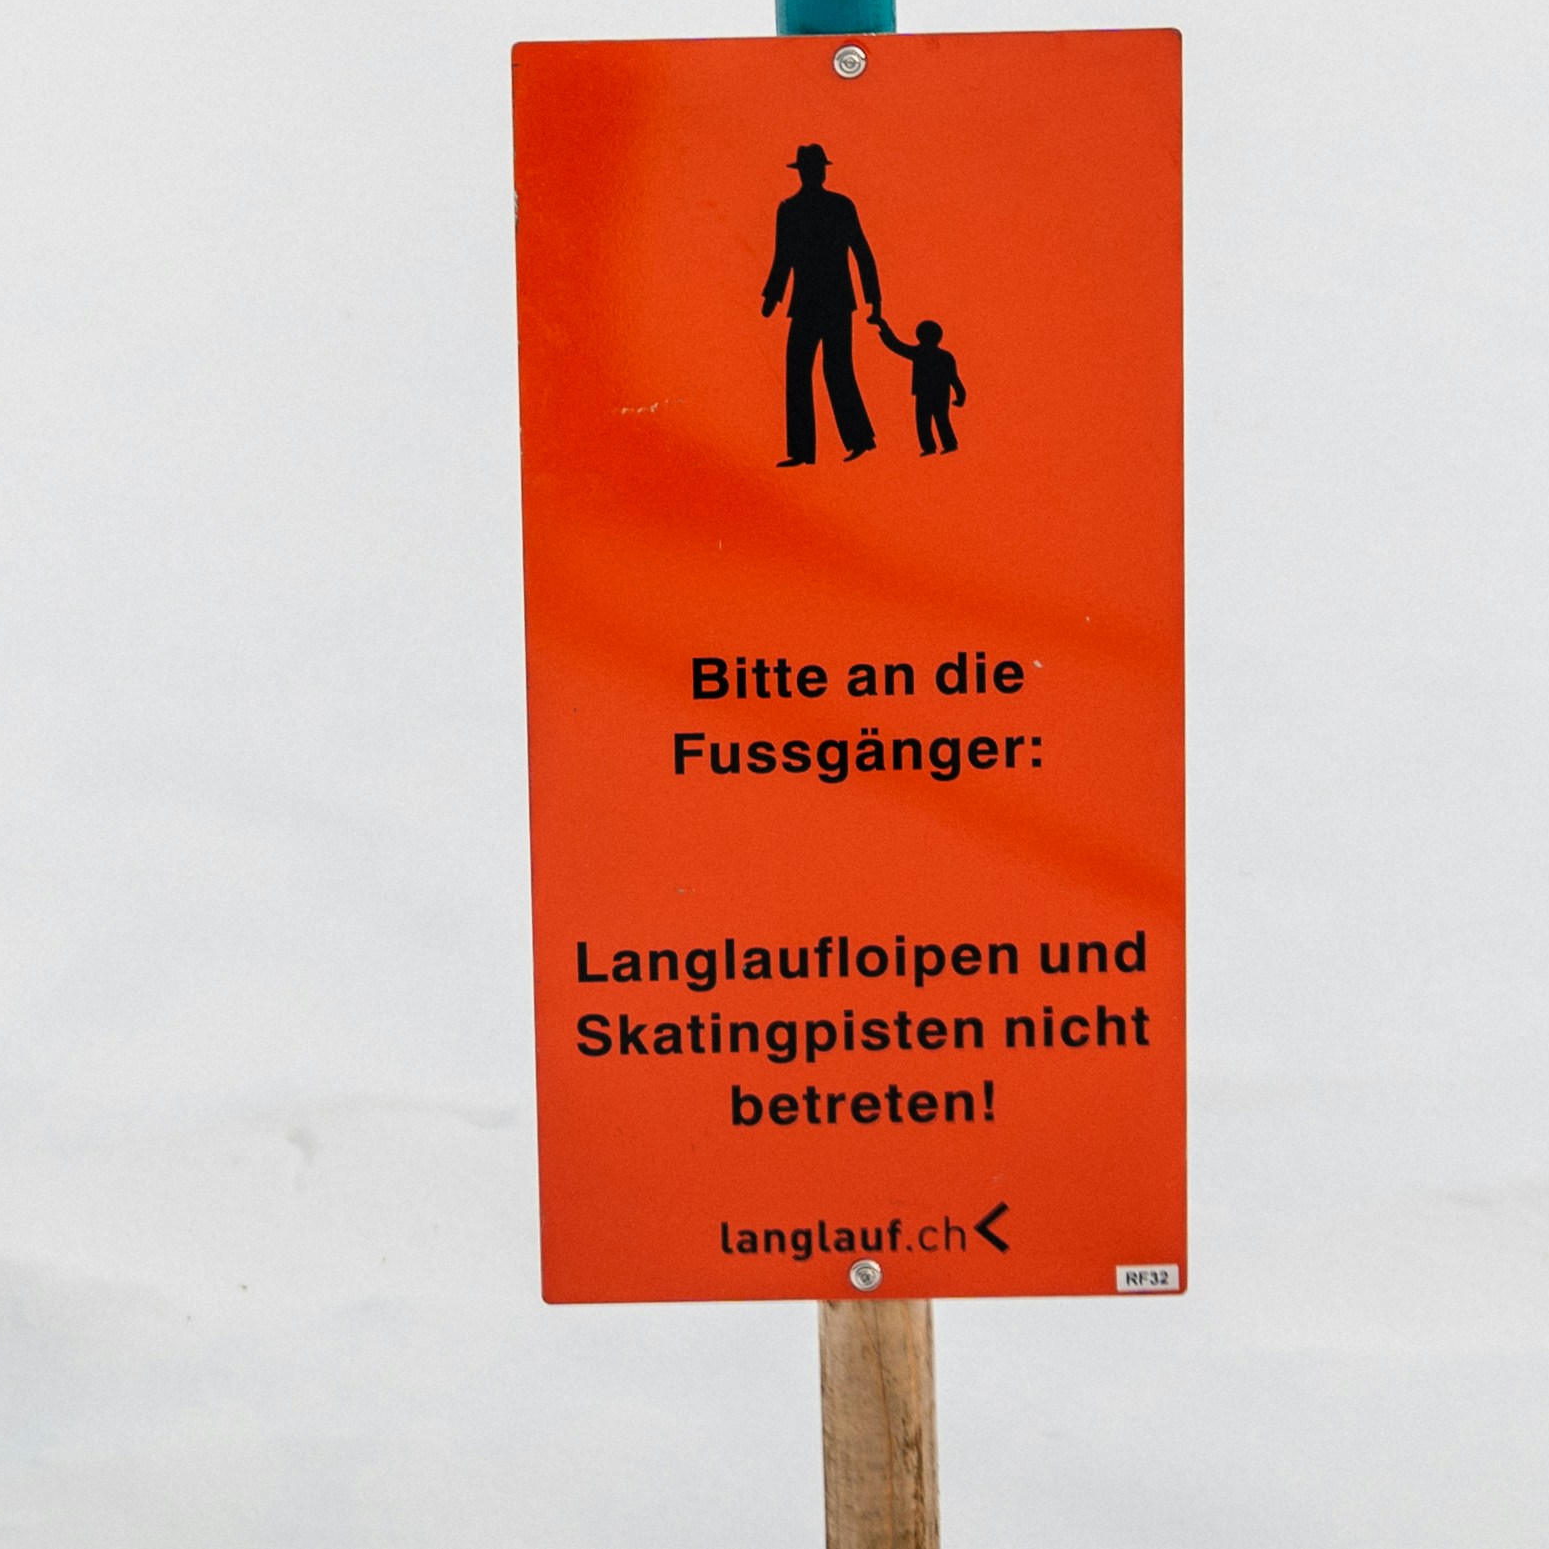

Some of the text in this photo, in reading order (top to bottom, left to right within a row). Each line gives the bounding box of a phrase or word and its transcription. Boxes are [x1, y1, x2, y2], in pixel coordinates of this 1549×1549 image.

[691, 651, 1025, 700] Bitte an die
[672, 727, 1044, 783] Fussgänger:
[575, 930, 1147, 993] Langlaufloipen und
[575, 1005, 1151, 1064] Skatingpisten nicht
[730, 1079, 996, 1127] betreten!
[720, 1216, 967, 1263] langlauf.ch
[1126, 1271, 1169, 1286] RF32
